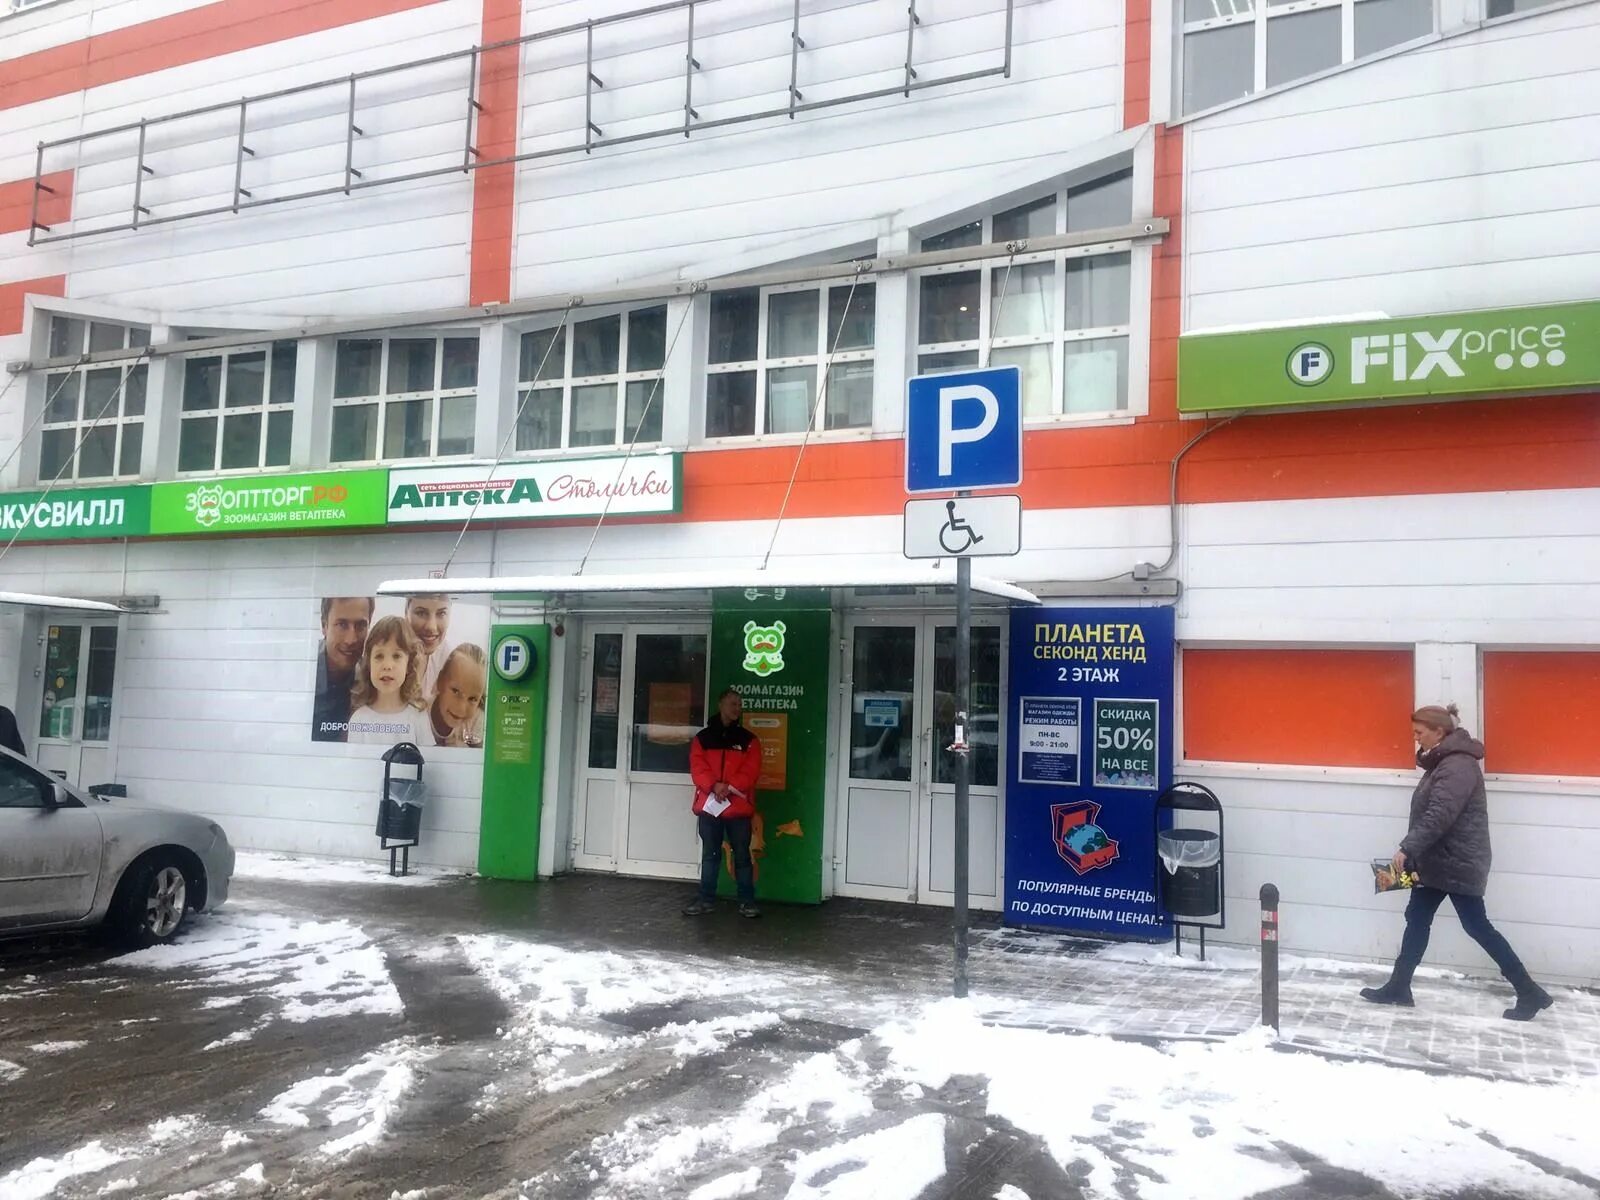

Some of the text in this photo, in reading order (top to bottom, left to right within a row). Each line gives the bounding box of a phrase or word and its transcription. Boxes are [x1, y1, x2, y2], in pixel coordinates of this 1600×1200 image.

[1462, 324, 1566, 360] price
[938, 384, 999, 477] P
[547, 470, 672, 502] Столички
[0, 499, 125, 529] КУСВИЛЛ
[223, 509, 346, 524] ЗООМАГАЗИН ВЕТАПТЕКА
[1034, 623, 1145, 643] ПЛАНЕТА
[1033, 645, 1147, 663] СЕКОНД ХЕНД
[1057, 667, 1120, 682] 2 ЭТАЖ
[741, 699, 798, 709] ЕТАПТЕКА
[1100, 709, 1151, 722] СКИДКА
[320, 722, 349, 732] ДОБРО
[1097, 726, 1154, 751] 50%
[1102, 757, 1149, 771] НА ВСЕ
[1017, 879, 1101, 897] ПОПУЛЯРНЫЕ
[1011, 900, 1030, 913] ПО
[1031, 902, 1114, 920] ДОСТУПНЫМ
